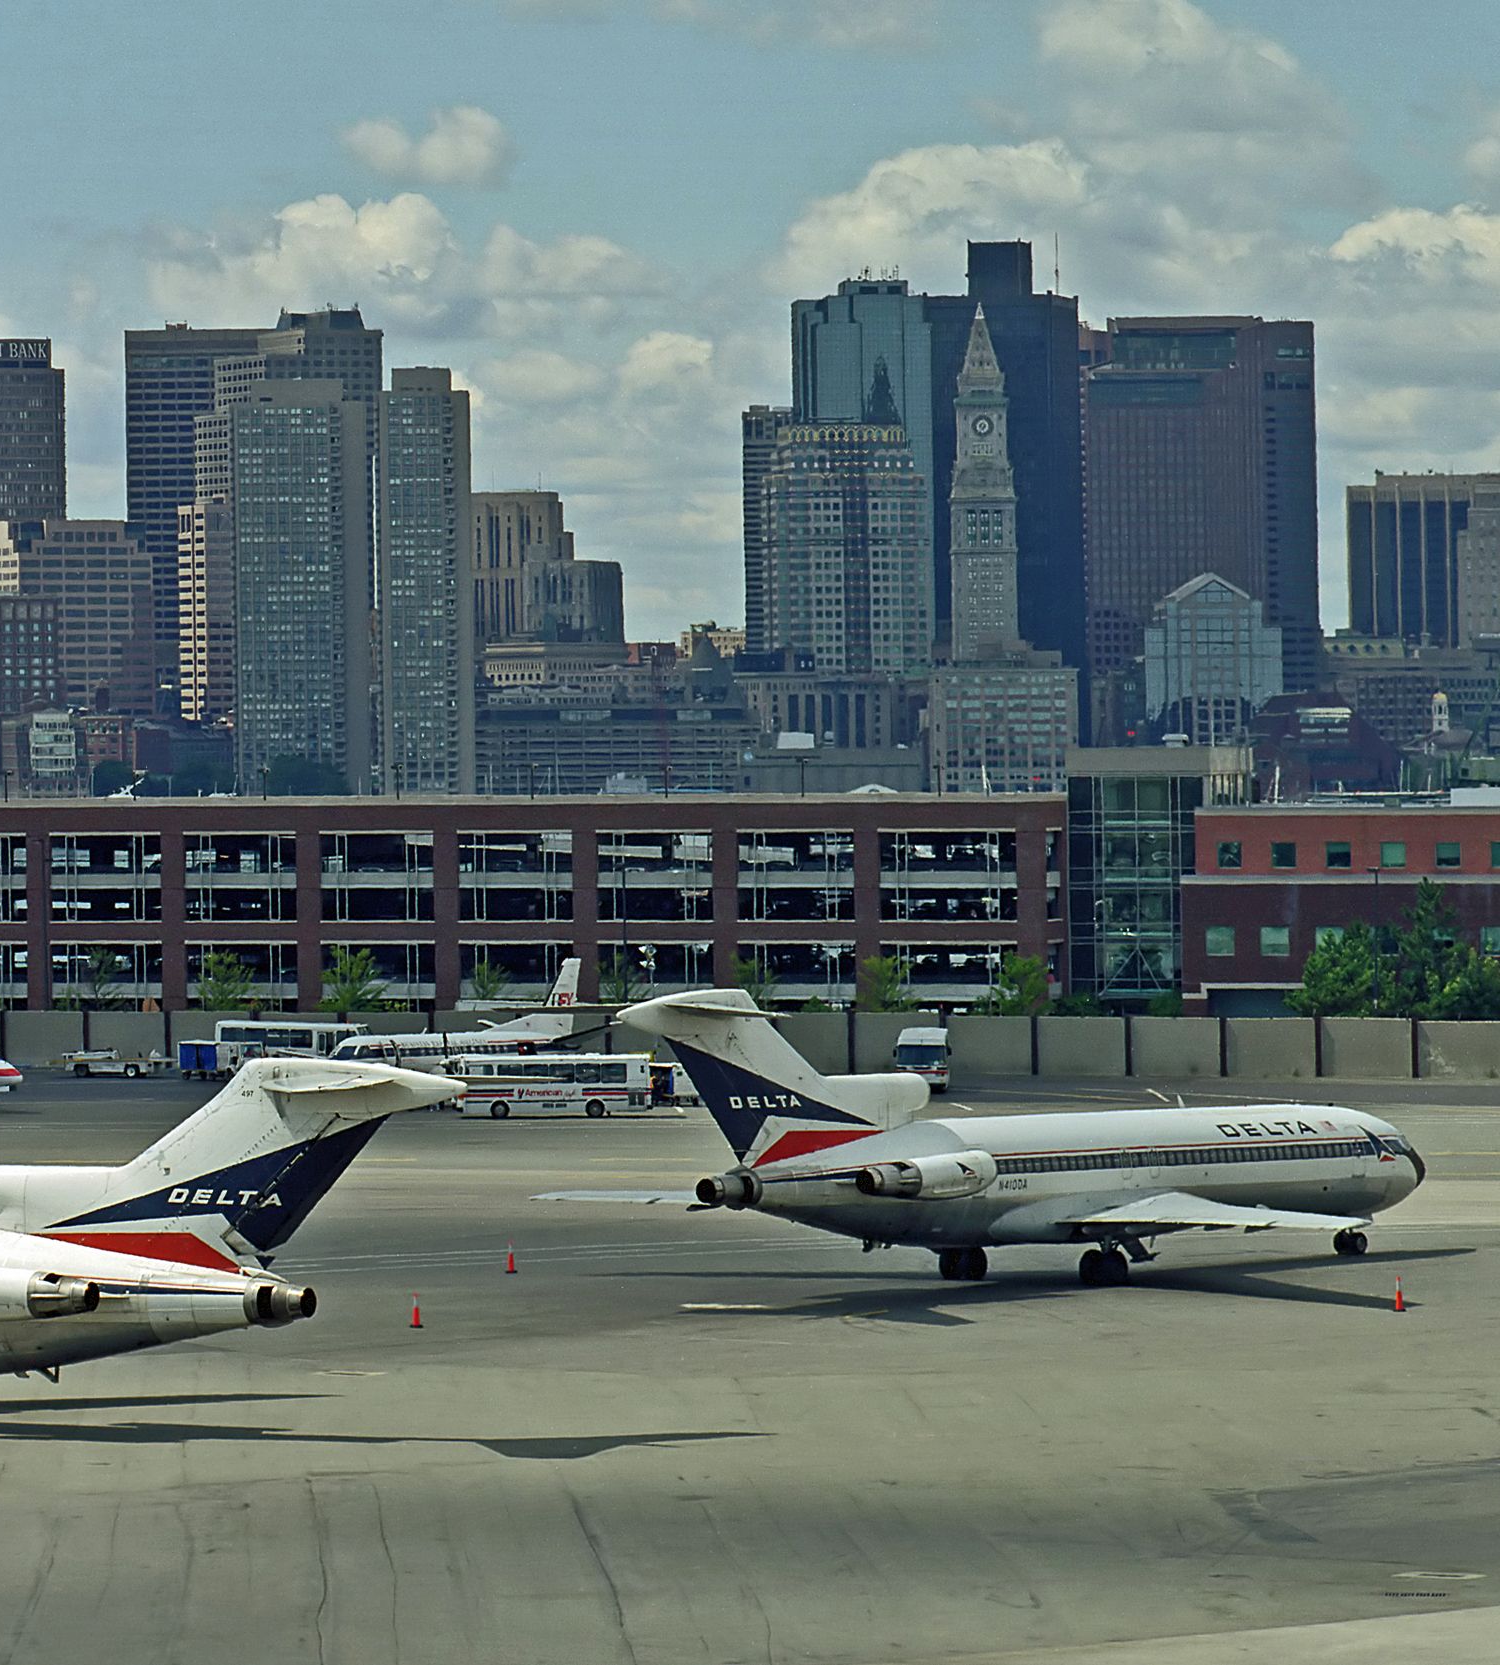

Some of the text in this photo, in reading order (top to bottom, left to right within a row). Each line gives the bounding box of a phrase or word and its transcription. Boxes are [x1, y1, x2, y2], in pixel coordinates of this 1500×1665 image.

[9, 342, 47, 358] BANK
[525, 1088, 563, 1097] American
[729, 1094, 802, 1109] DELTA
[1216, 1120, 1318, 1138] DELTA
[167, 1188, 282, 1208] DELTA
